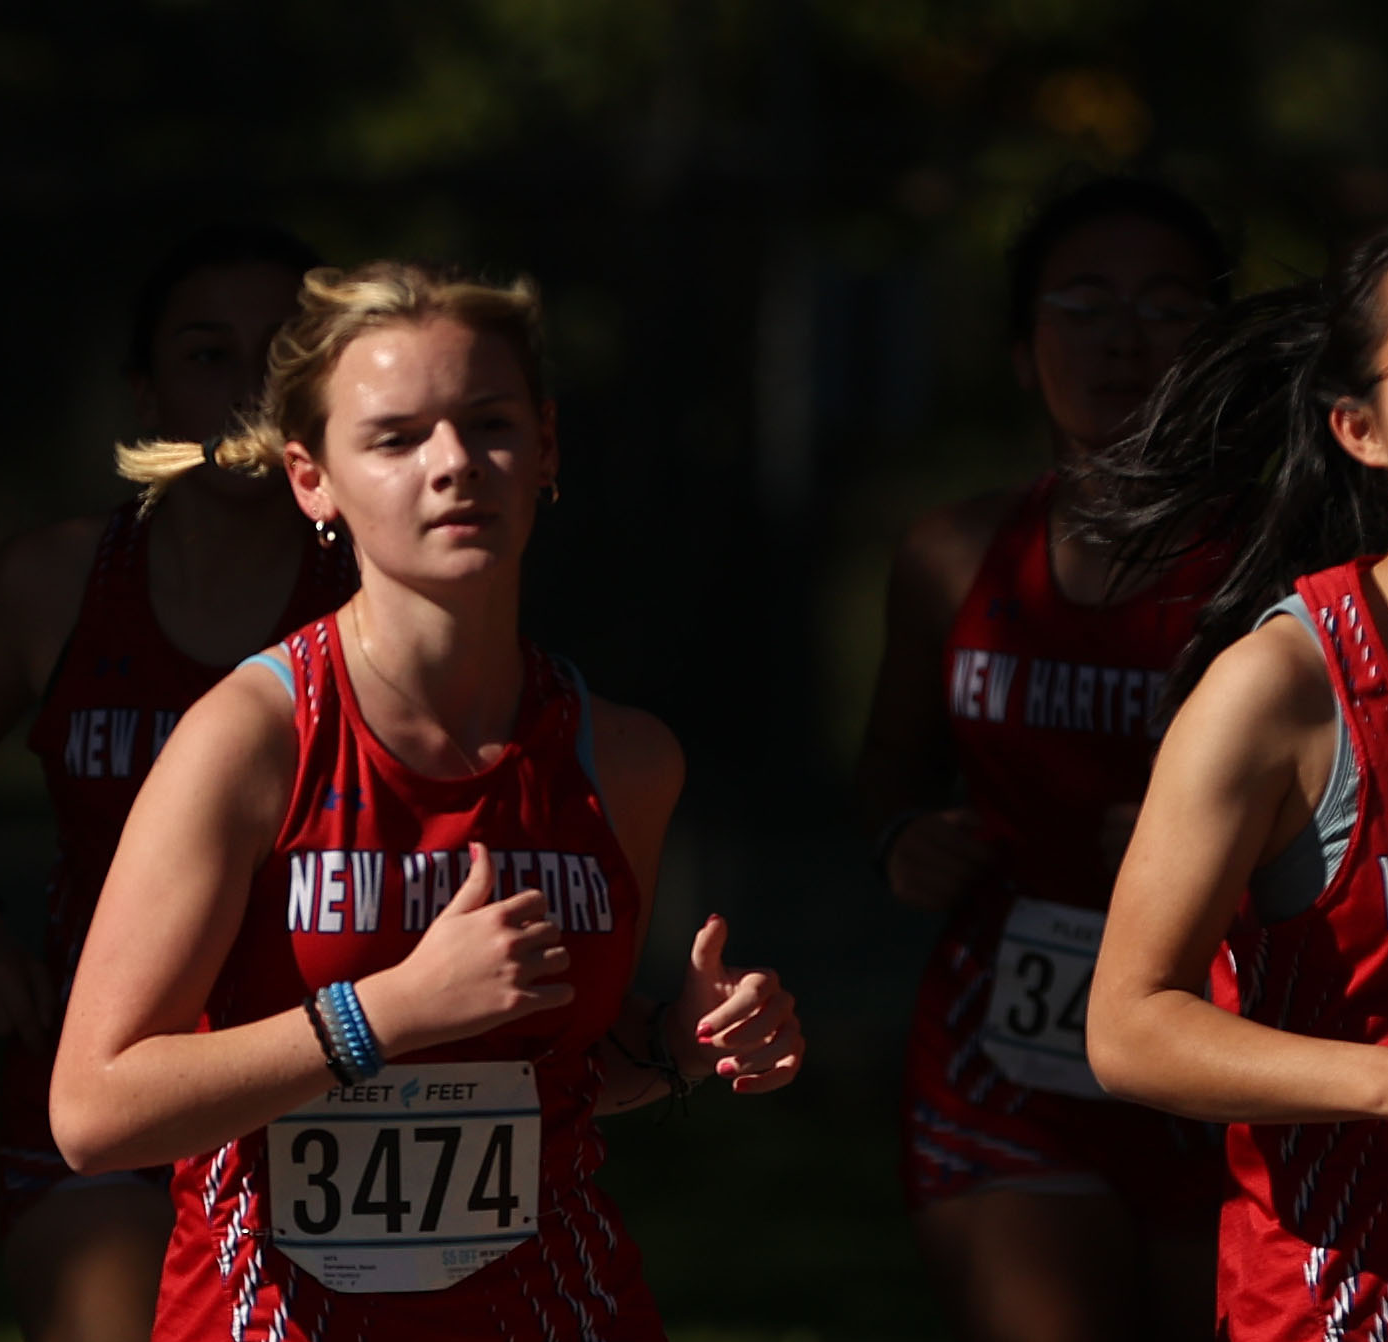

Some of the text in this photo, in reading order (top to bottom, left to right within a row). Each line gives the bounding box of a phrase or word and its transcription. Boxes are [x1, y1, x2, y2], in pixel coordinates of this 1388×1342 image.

[950, 648, 1018, 725] NEW
[63, 706, 141, 780] NEW
[286, 850, 384, 932] NEW
[425, 1082, 479, 1102] FEET
[291, 1123, 519, 1236] 3474
